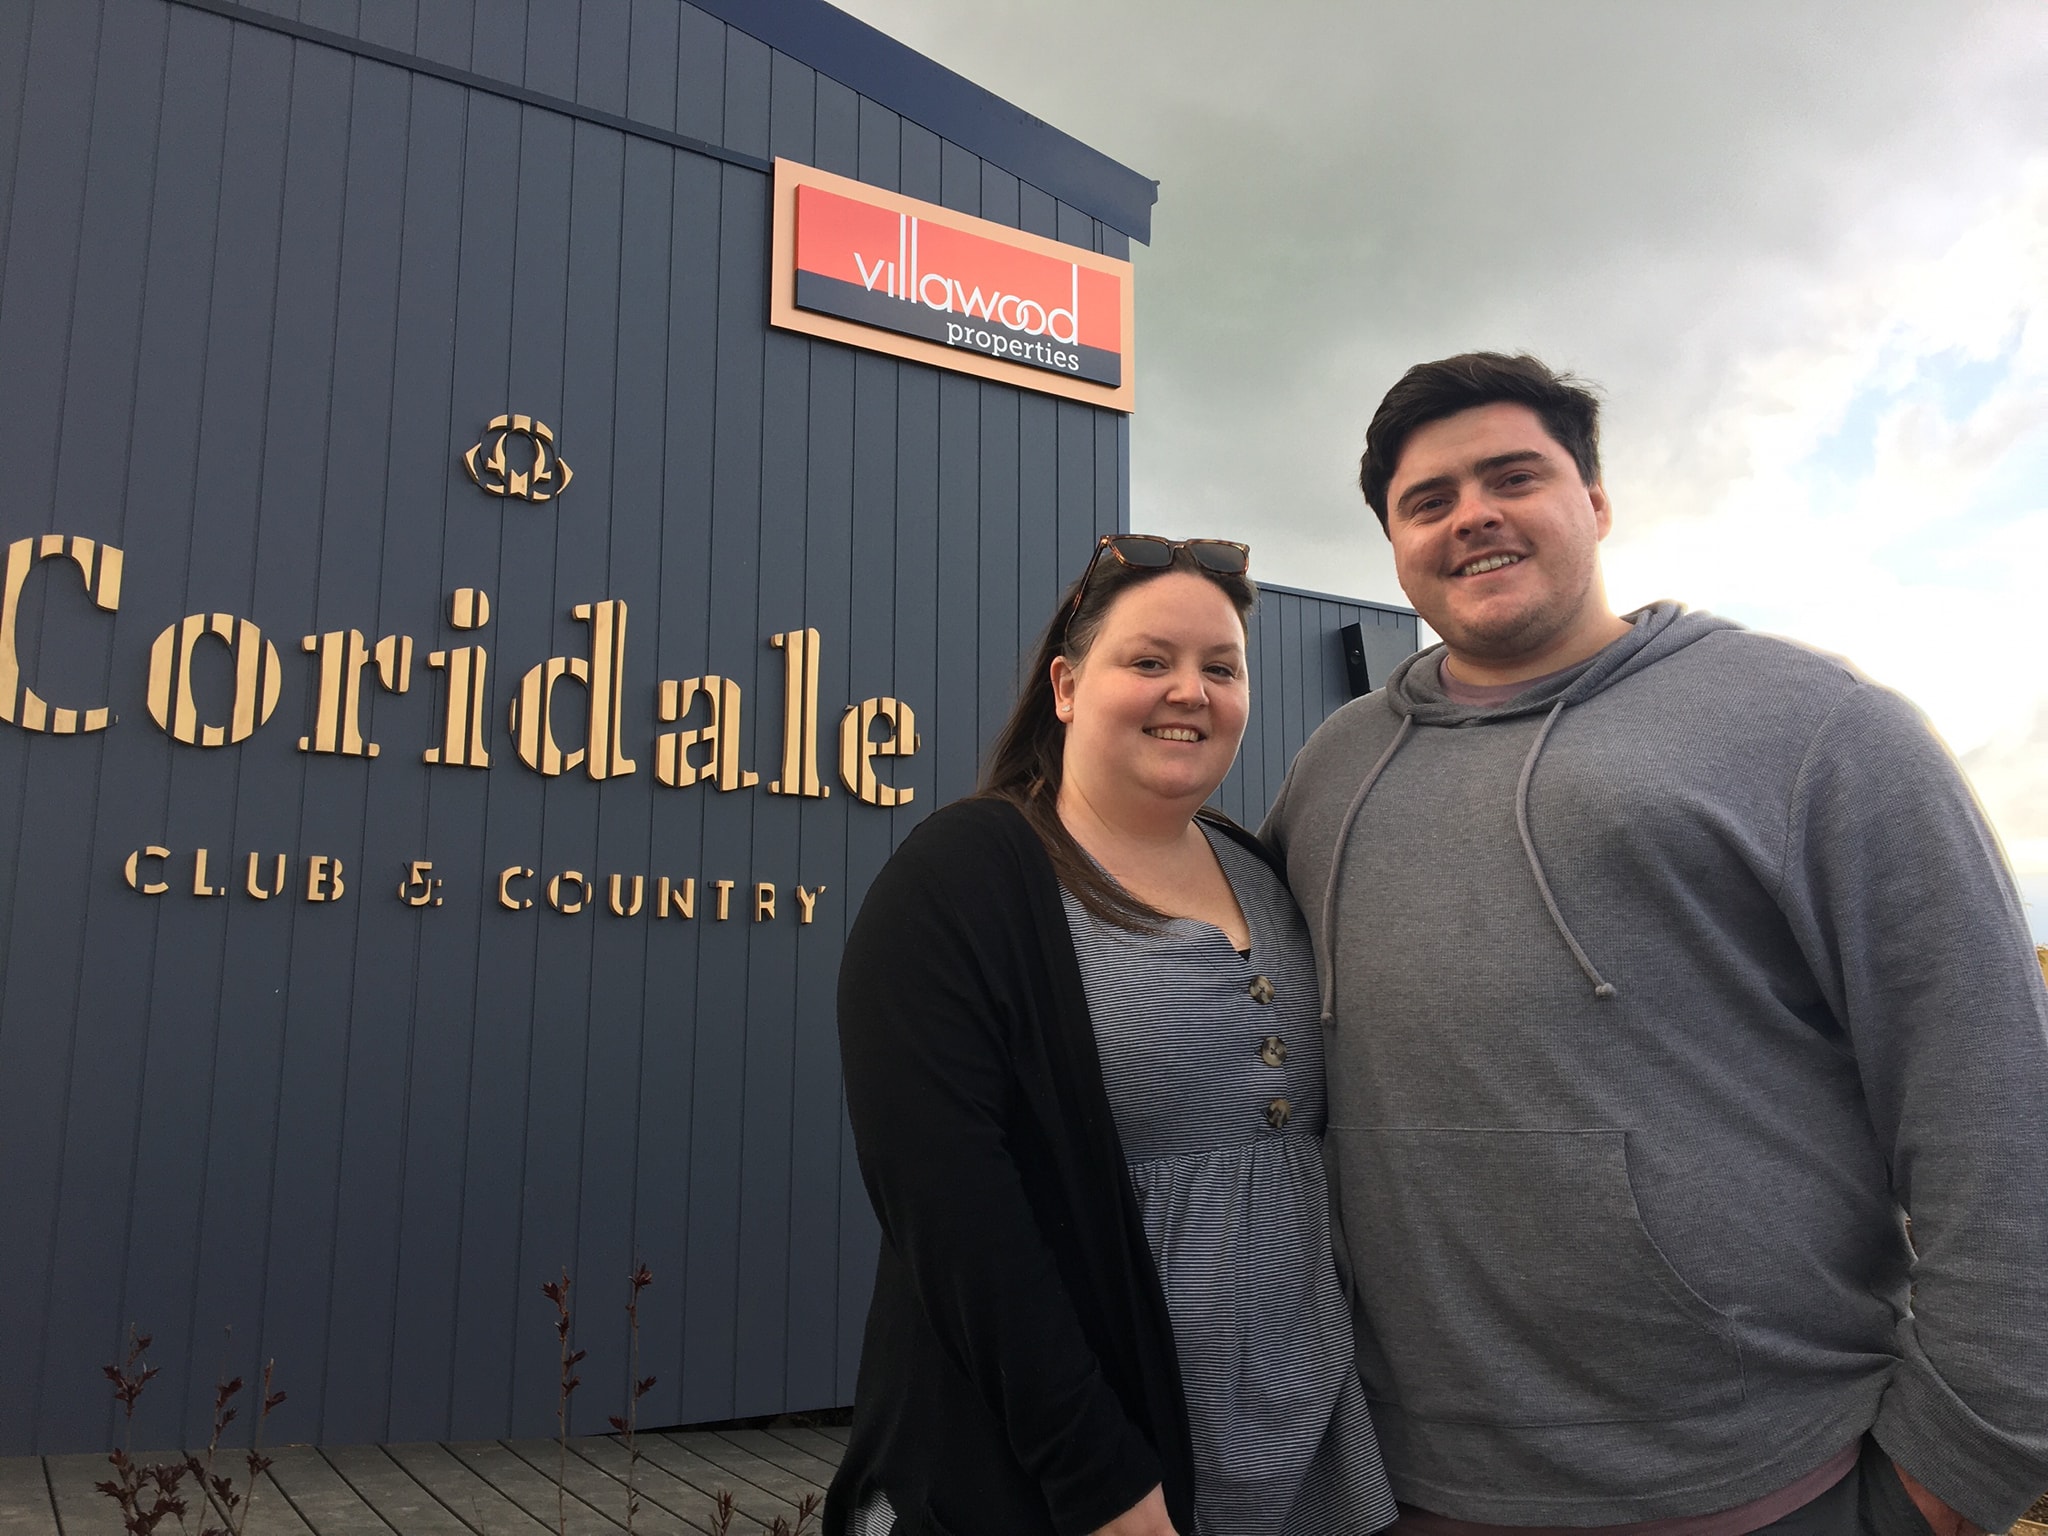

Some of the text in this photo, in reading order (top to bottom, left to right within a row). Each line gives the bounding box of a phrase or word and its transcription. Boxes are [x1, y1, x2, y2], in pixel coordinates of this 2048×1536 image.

[853, 214, 1079, 346] villawood
[946, 321, 1079, 371] properties
[0, 534, 921, 807] Coridale
[125, 845, 826, 924] CLUB & COUNTRY
